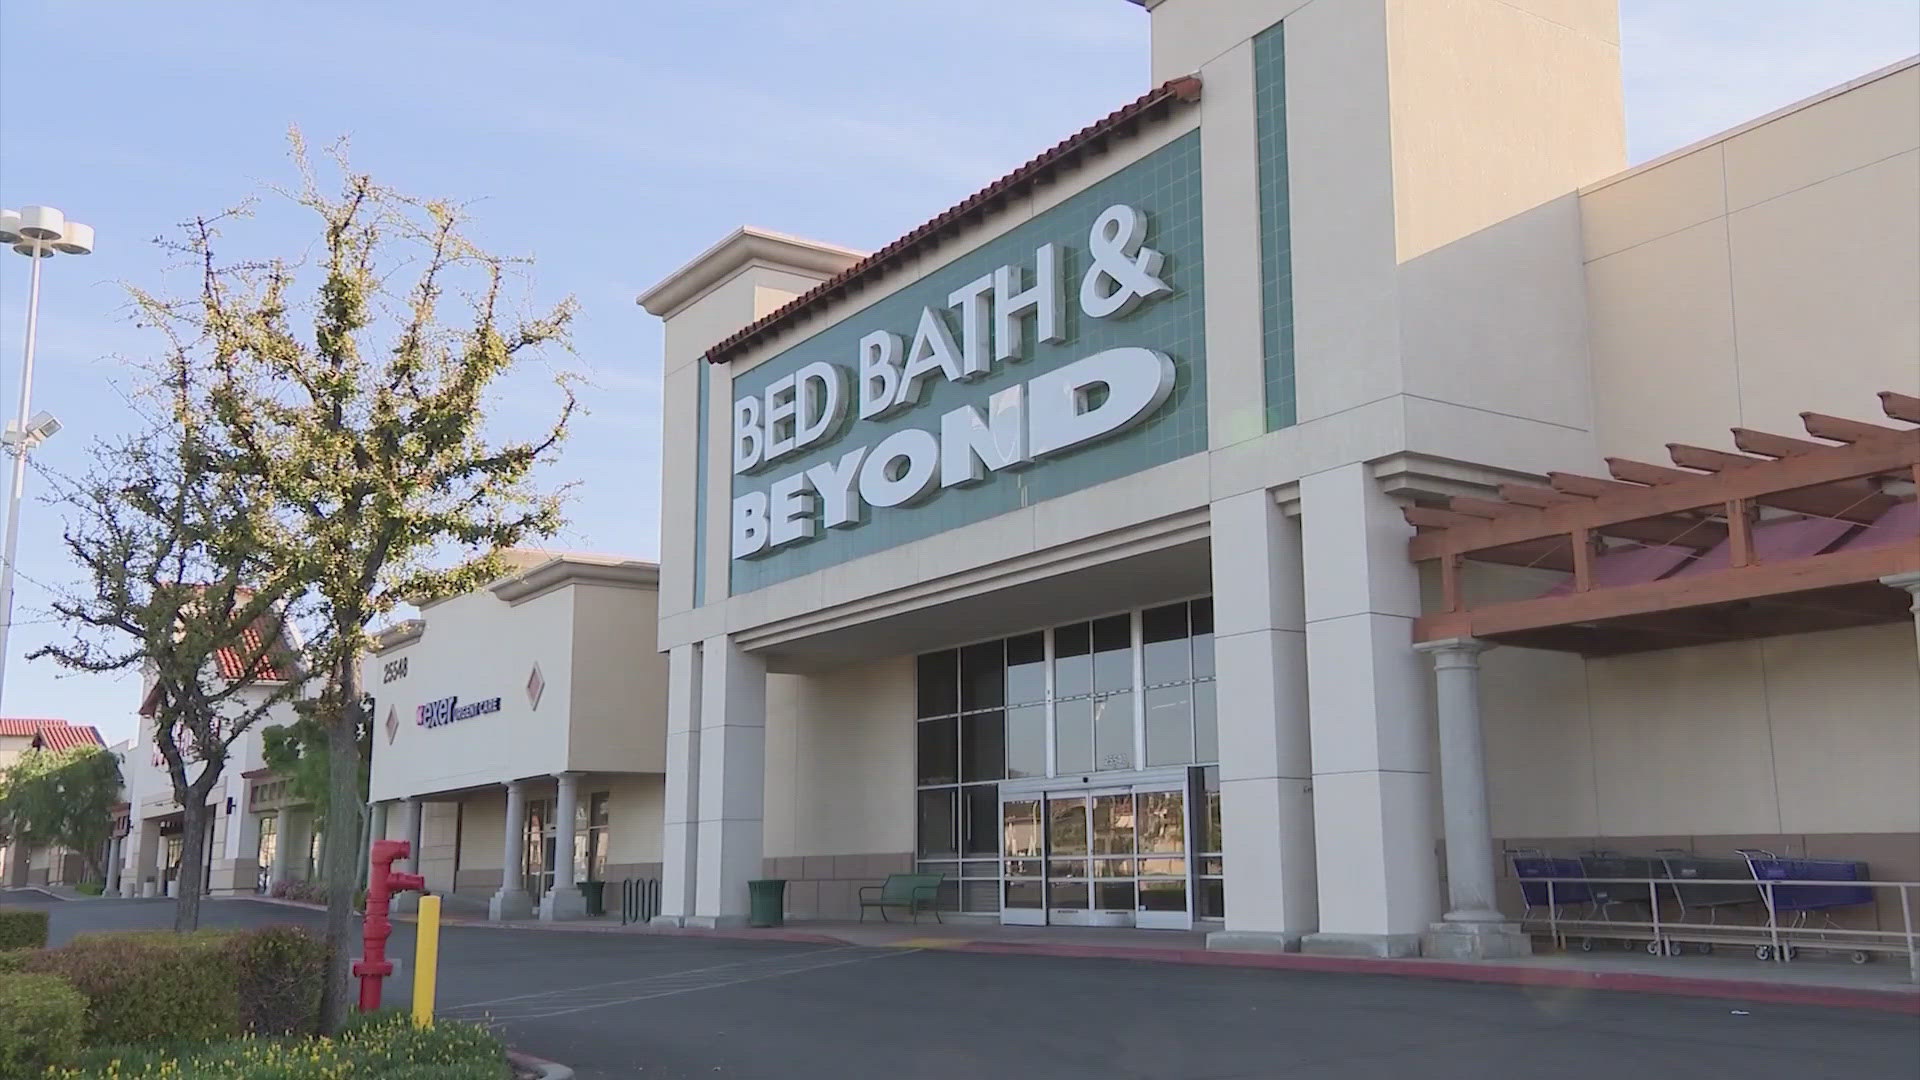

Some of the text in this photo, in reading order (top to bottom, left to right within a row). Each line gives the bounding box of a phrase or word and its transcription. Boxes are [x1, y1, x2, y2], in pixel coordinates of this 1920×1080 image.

[734, 204, 1173, 475] BED BATH &
[732, 346, 1177, 560] BEYOND
[383, 656, 408, 684] 25548
[424, 695, 501, 729] exer URGENT CARE
